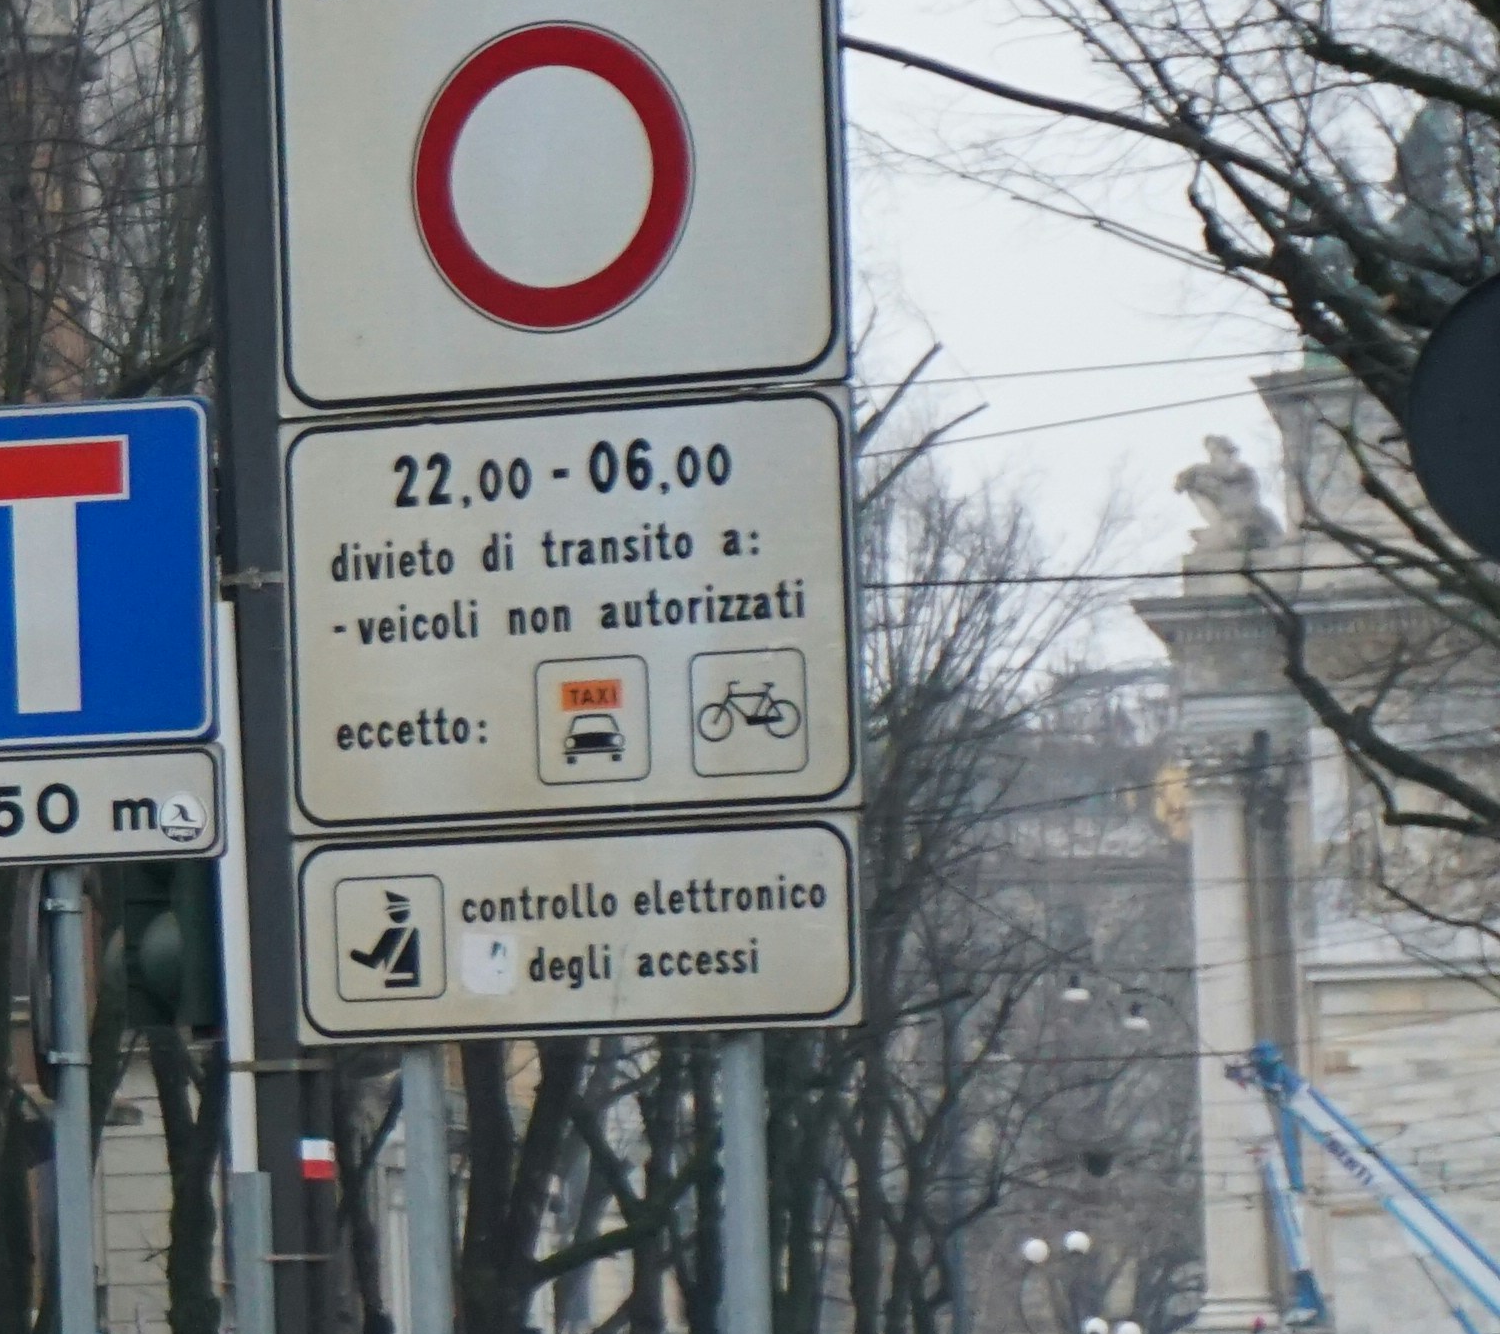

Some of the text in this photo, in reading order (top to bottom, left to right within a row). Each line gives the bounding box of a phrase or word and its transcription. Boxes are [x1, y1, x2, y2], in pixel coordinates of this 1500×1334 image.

[330, 522, 762, 583] divieto di transito a:
[508, 604, 573, 636] non
[599, 579, 807, 629] autorizzati
[569, 687, 619, 706] TAXI
[335, 706, 489, 752] eccetto:
[112, 796, 159, 833] m
[461, 874, 828, 927] controllo elettronico
[527, 936, 760, 990] degli accessi
